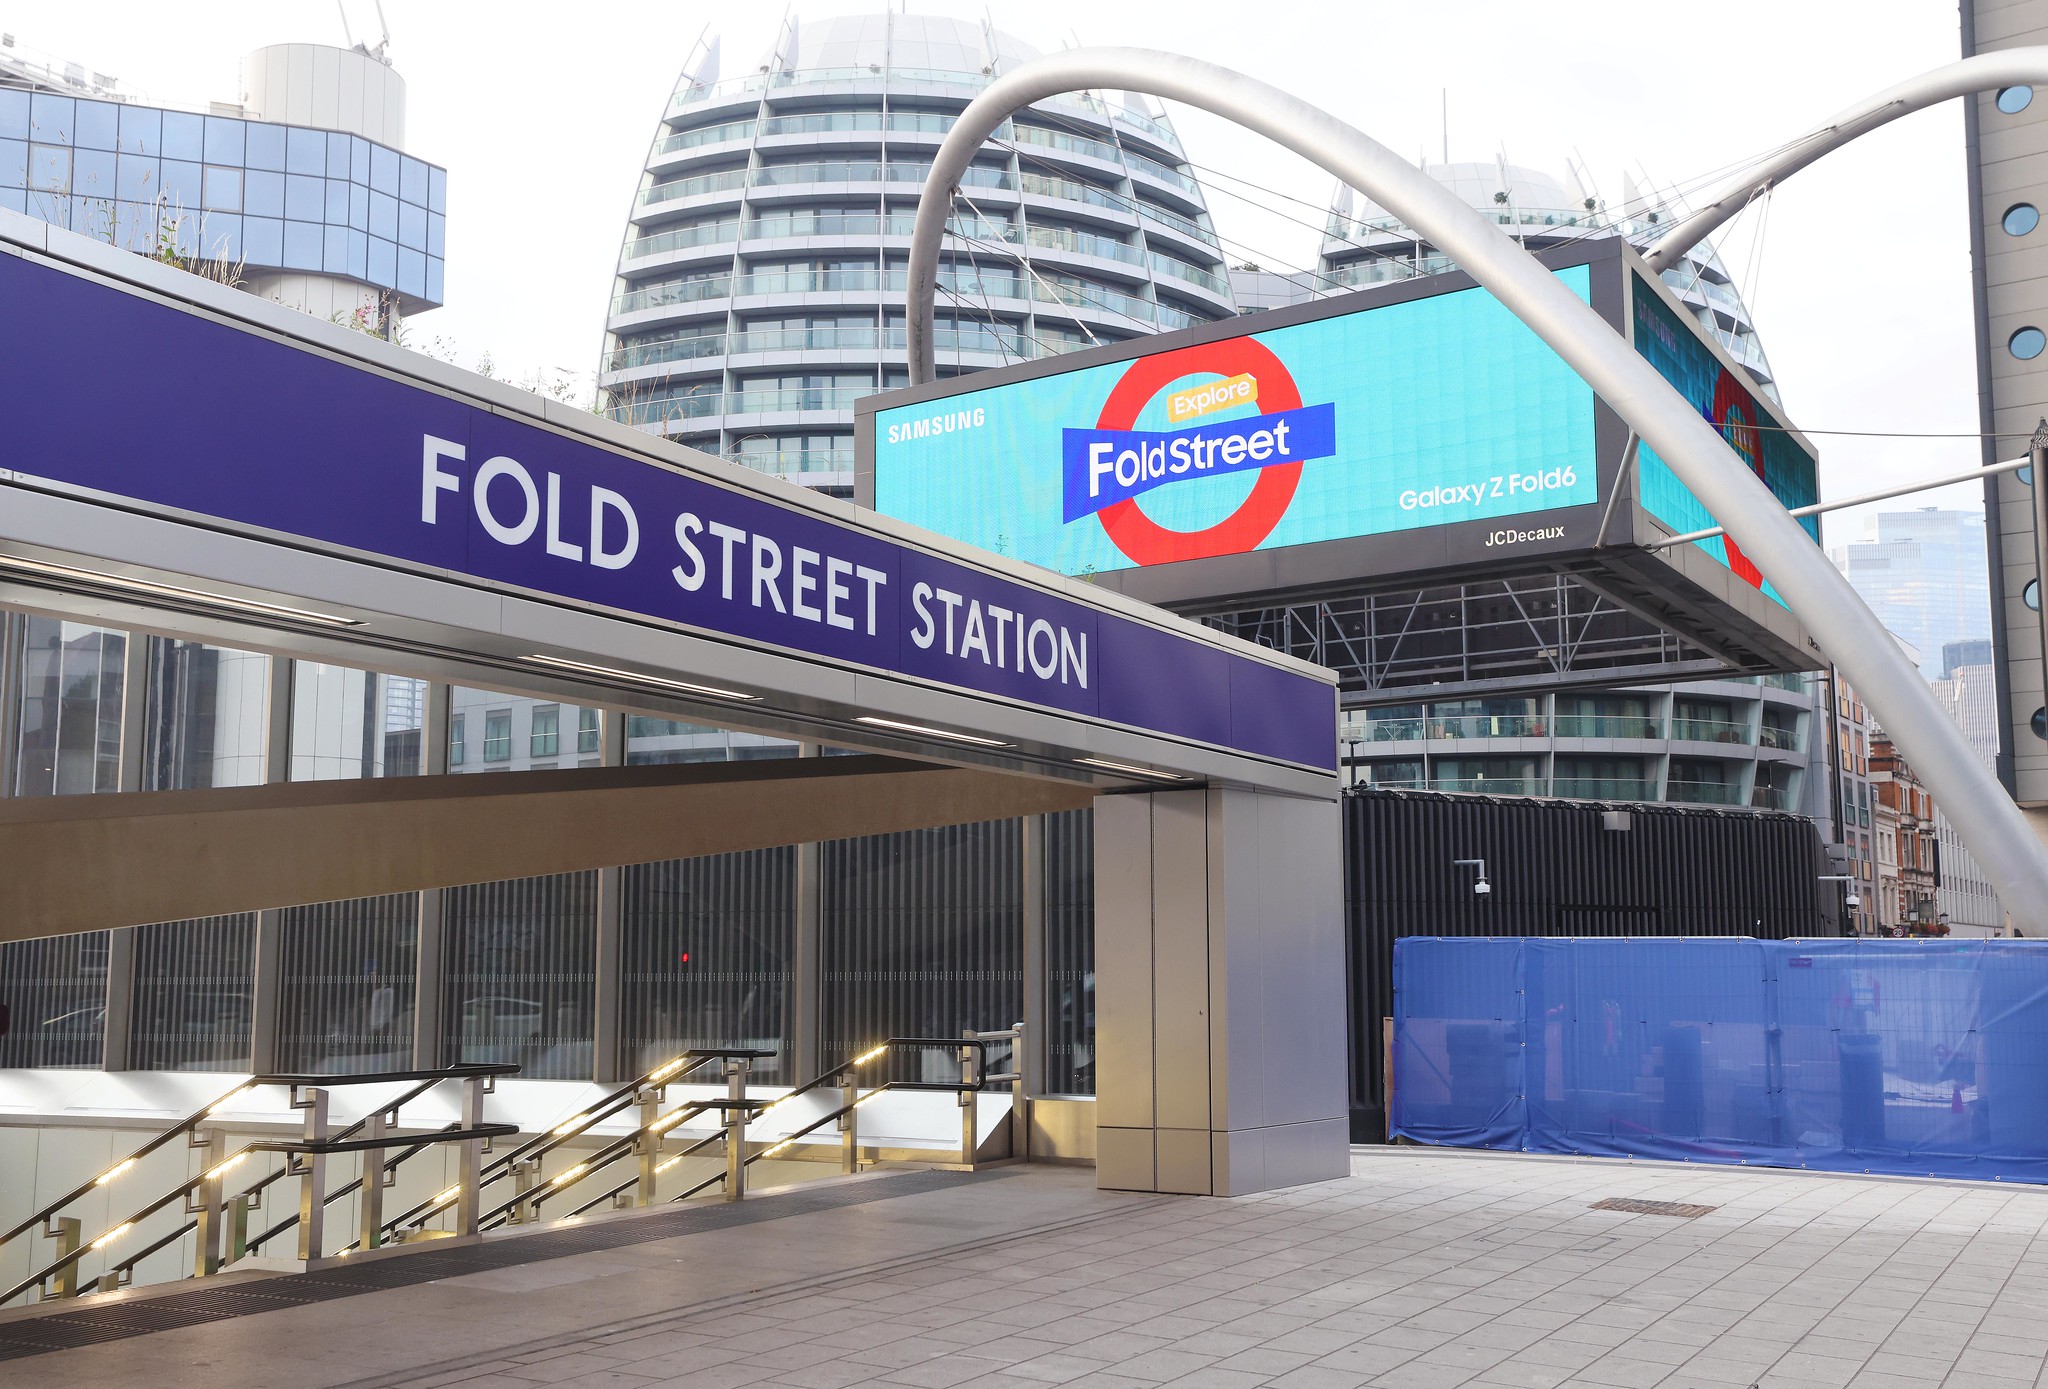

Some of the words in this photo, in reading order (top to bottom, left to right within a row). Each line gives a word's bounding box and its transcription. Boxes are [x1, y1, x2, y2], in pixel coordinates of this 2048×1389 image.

[1174, 380, 1251, 415] Explore
[888, 407, 985, 444] SAMSUNG
[1399, 482, 1487, 511] Galaxy
[1490, 476, 1504, 498] Z
[1509, 465, 1577, 495] Fold6
[1485, 526, 1565, 547] JCDecaux
[421, 433, 639, 570] FOLD
[672, 512, 887, 636] STREET
[911, 581, 1087, 689] STATION
